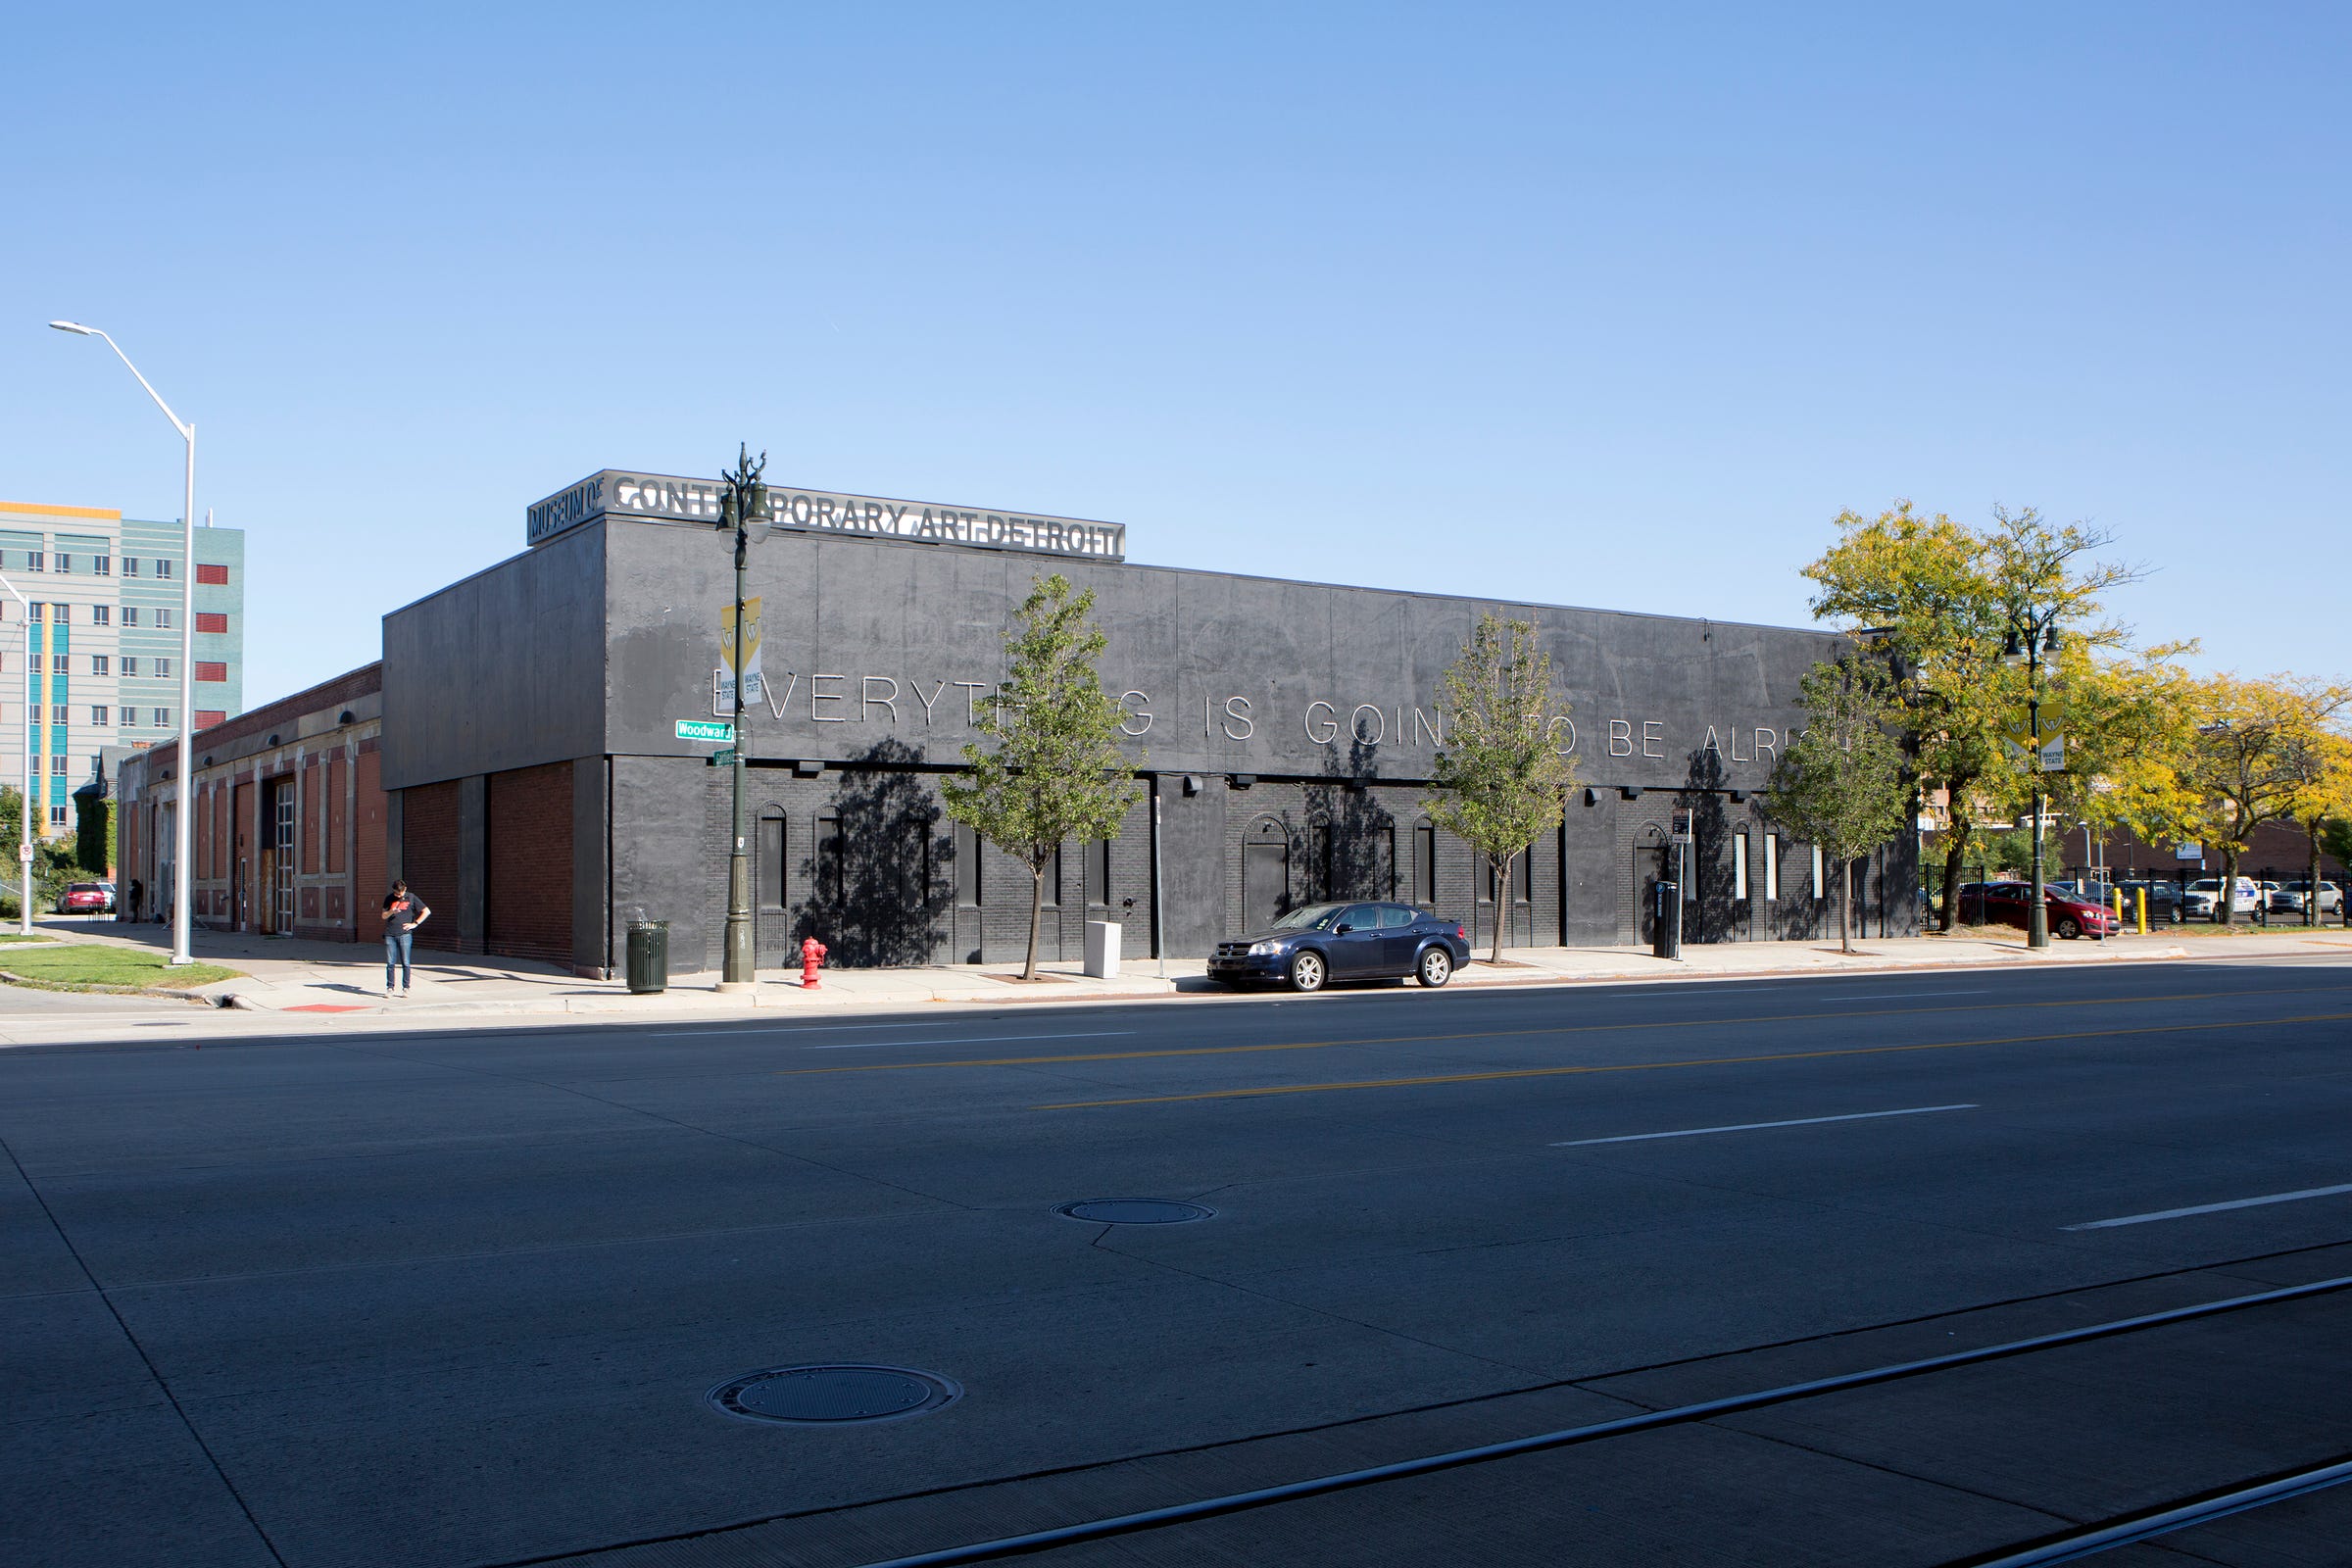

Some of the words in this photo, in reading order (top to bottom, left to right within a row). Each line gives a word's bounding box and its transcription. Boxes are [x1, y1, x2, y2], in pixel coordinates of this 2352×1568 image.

[531, 485, 584, 539] MUSEUM
[586, 476, 606, 512] OF
[612, 475, 908, 537] CONTEPORARY
[917, 507, 979, 543] ART
[987, 514, 1114, 557] DETROIT
[678, 722, 731, 739] Woodward
[1204, 695, 1253, 741] IS
[1608, 718, 1664, 759] BE
[2042, 750, 2064, 759] WAYNE
[2044, 757, 2062, 765] STATE
